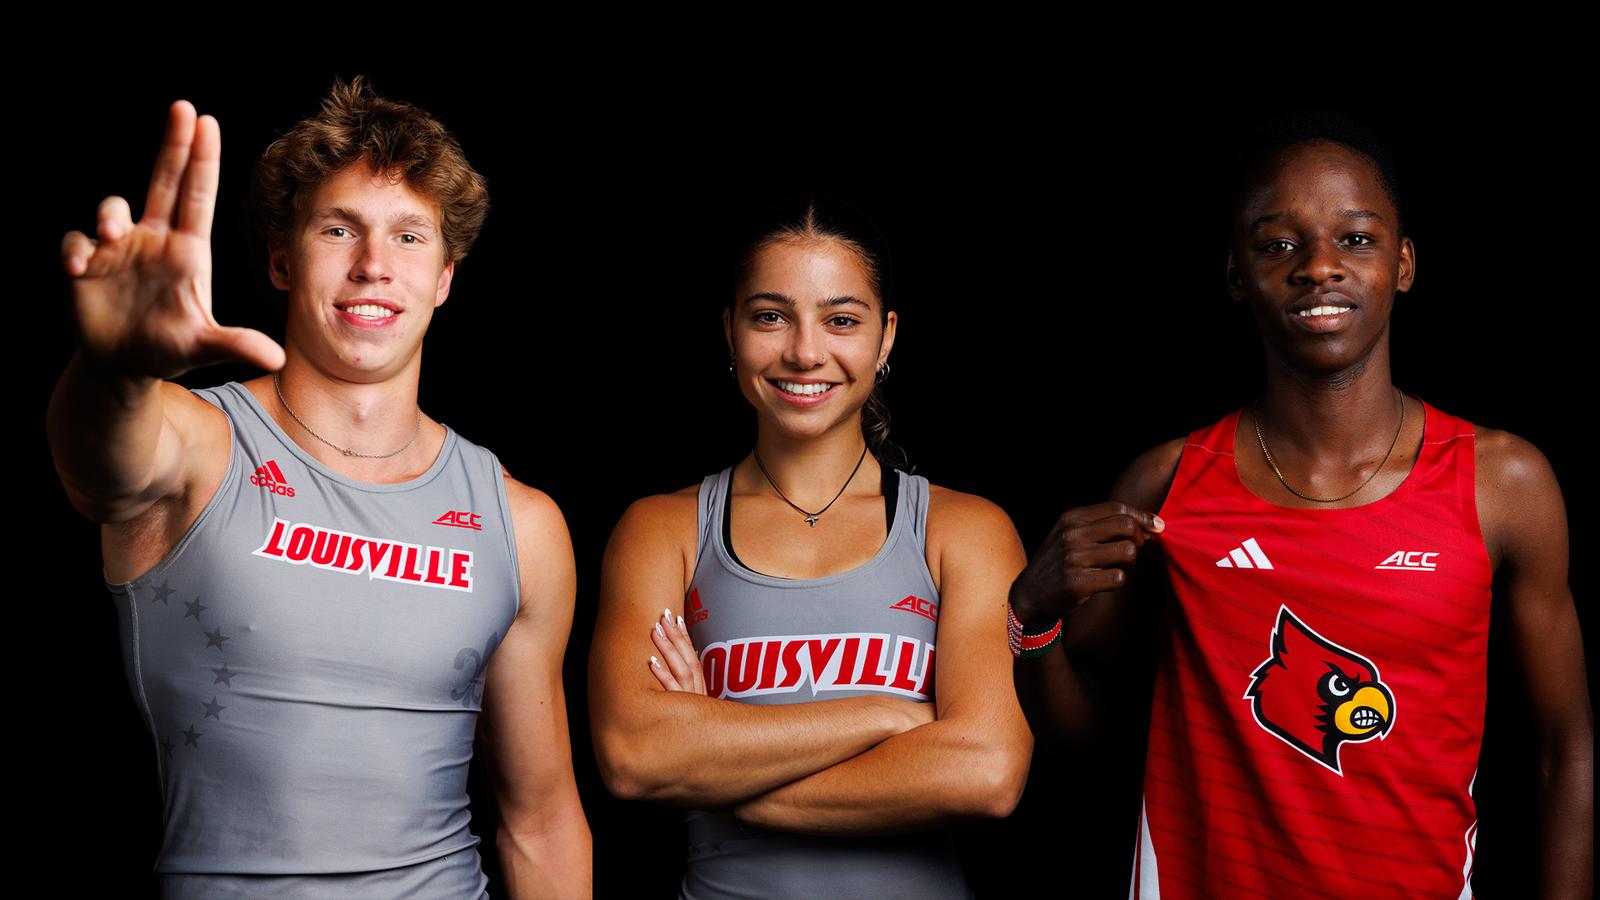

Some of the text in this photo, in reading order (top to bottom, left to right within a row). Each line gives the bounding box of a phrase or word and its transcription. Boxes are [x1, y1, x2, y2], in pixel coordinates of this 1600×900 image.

[250, 474, 296, 498] addas
[433, 510, 483, 530] ACC
[256, 518, 473, 592] LOUISVILLE
[1375, 550, 1441, 571] ACC
[701, 634, 936, 699] OUISVILL
